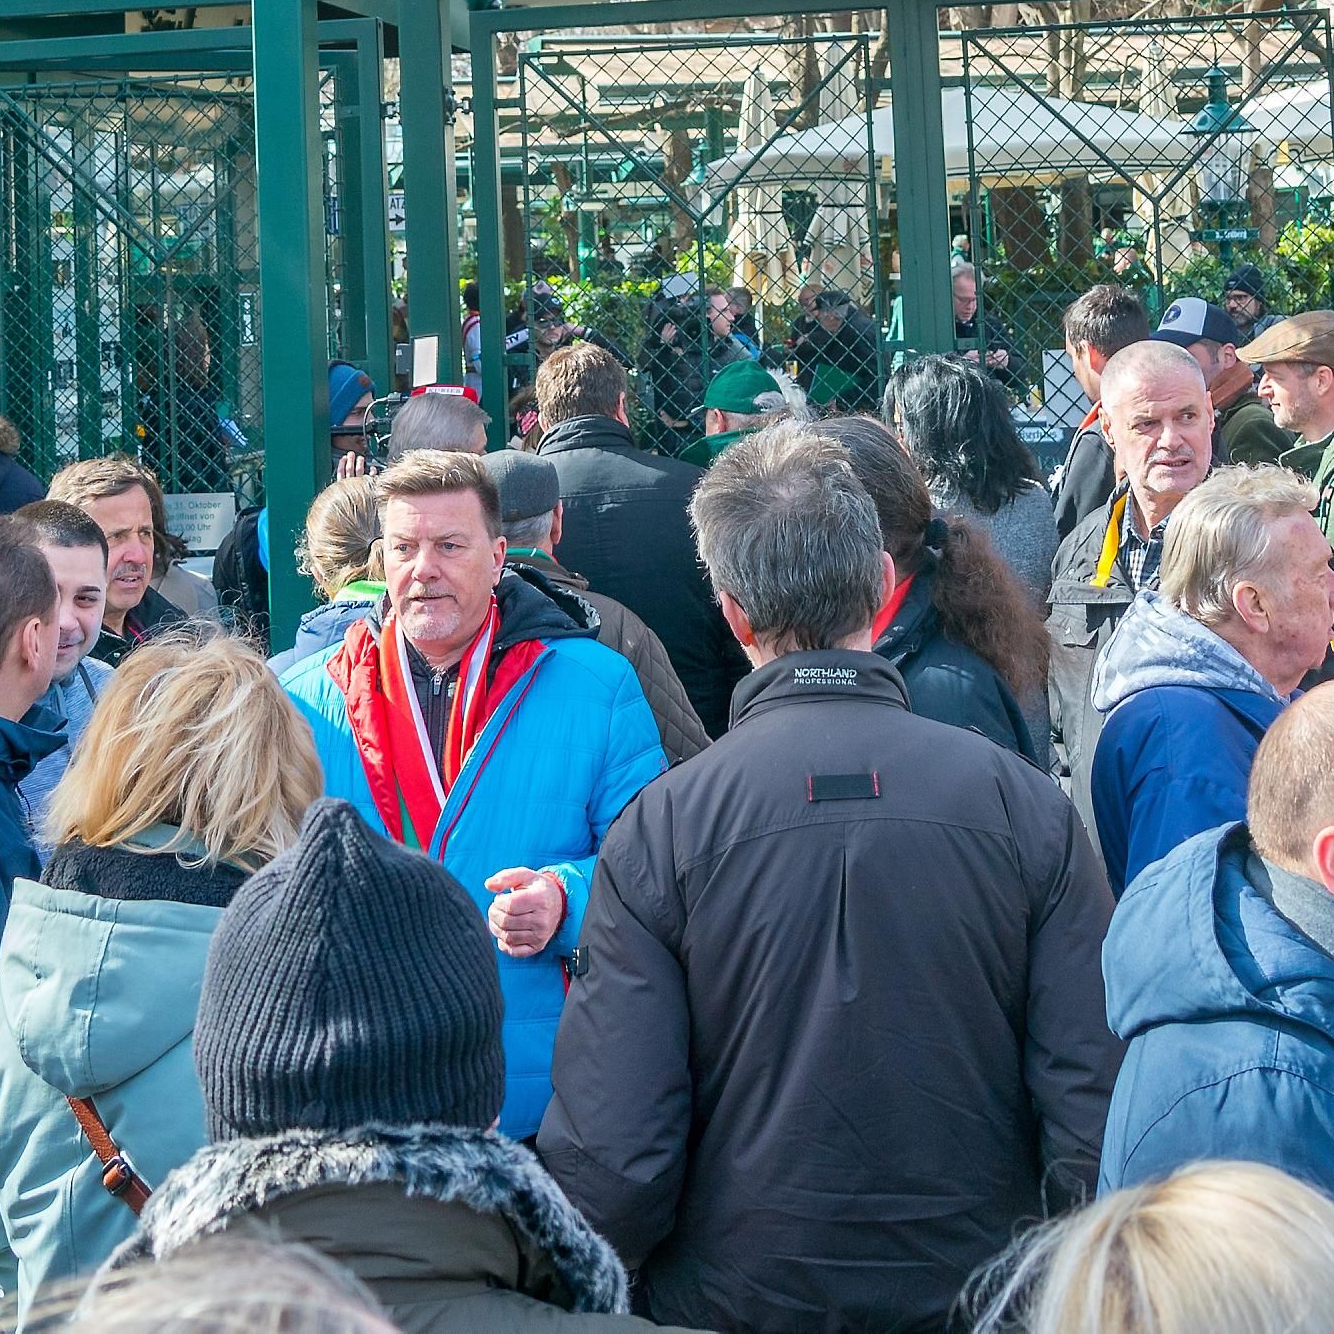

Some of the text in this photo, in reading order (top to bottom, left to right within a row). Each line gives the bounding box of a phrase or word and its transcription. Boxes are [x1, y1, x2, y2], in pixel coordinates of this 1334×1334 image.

[188, 501, 222, 510] Oktober
[197, 523, 212, 531] Uhr
[794, 668, 858, 679] NORTHLAND
[794, 678, 857, 686] PROFESSIONAL
